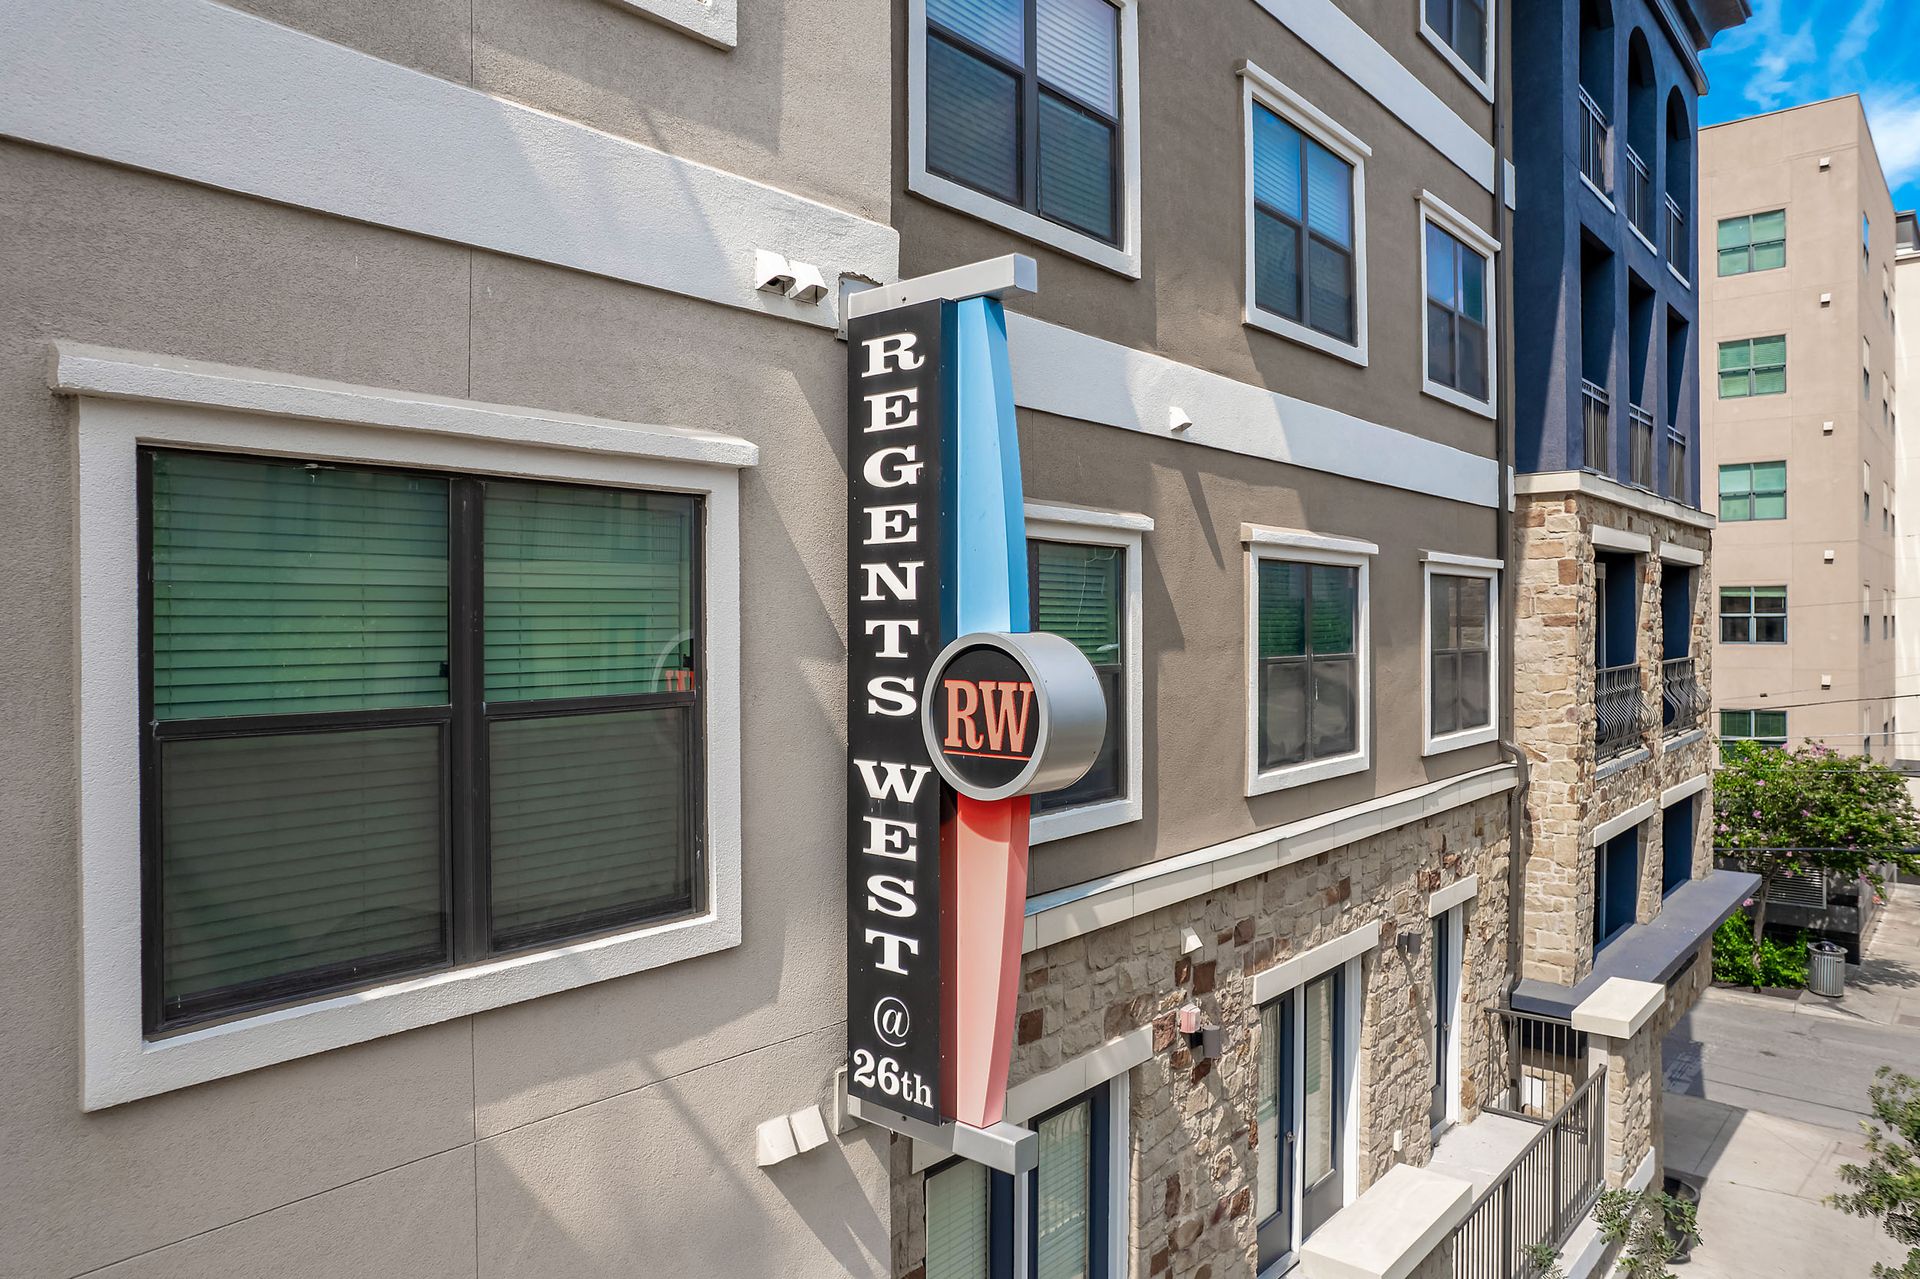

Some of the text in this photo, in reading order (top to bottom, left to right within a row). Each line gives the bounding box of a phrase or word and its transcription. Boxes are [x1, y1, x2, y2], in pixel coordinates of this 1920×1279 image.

[854, 333, 932, 976] REGENTS WEST
[944, 679, 1034, 753] RW
[873, 996, 910, 1047] @
[853, 1048, 934, 1109] 26th
